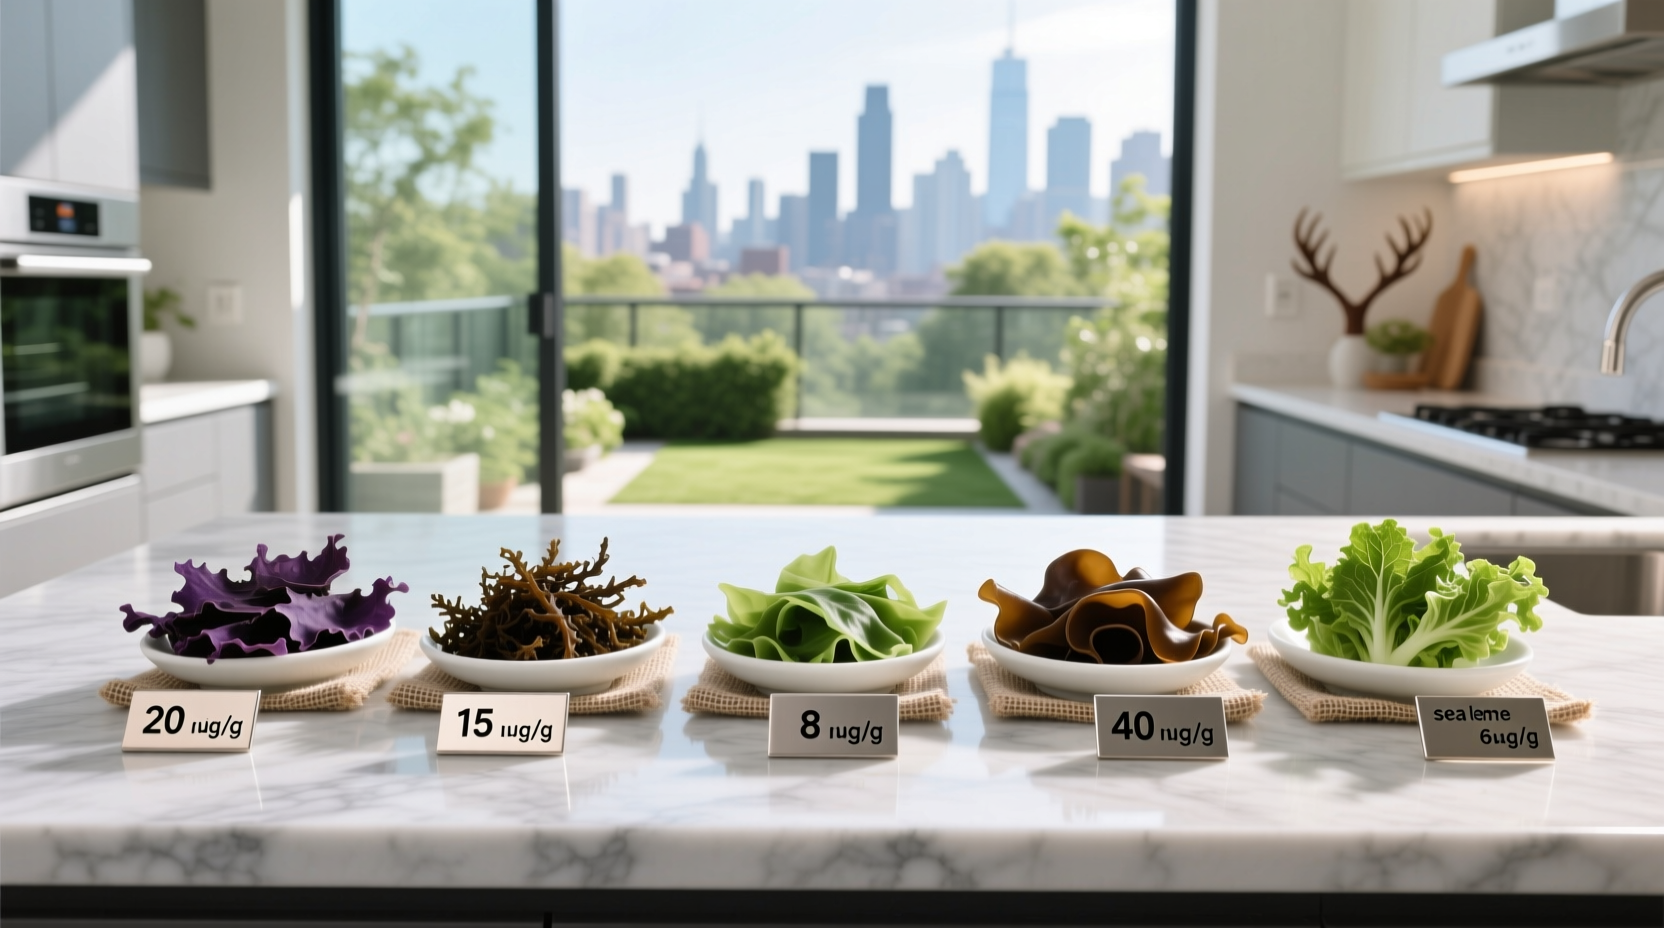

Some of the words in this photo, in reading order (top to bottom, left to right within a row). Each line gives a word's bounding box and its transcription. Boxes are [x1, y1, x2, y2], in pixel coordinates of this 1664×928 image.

[142, 705, 186, 735] 20
[457, 708, 494, 738] 15
[800, 709, 821, 740] 8
[1111, 710, 1155, 741] 40
